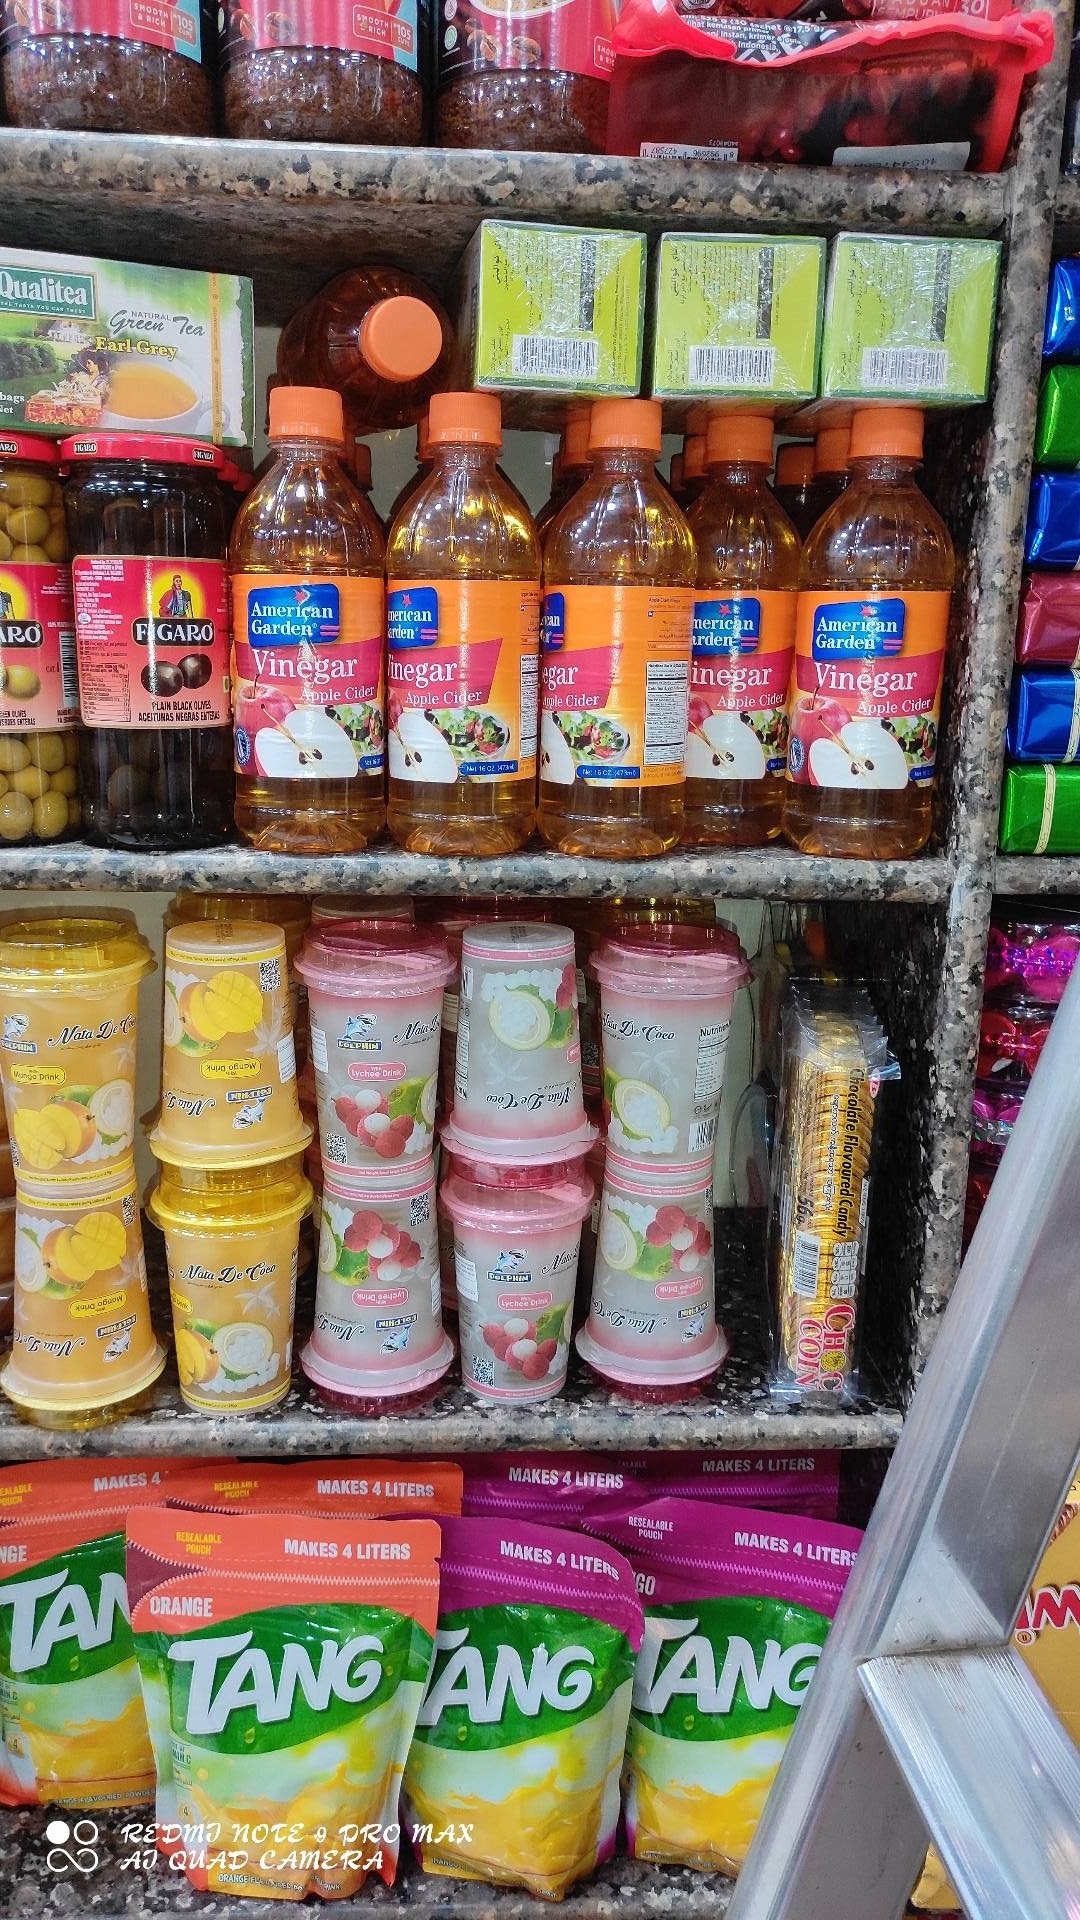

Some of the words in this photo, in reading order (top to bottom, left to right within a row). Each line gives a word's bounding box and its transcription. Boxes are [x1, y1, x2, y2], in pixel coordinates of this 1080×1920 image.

[134, 3, 168, 18] SMOOTH
[147, 15, 165, 27] RICH
[357, 14, 389, 28] SMOOTH
[369, 26, 385, 37] RICH
[0, 271, 88, 305] Qualitea
[110, 310, 164, 336] Green
[173, 316, 206, 337] Tea
[131, 310, 171, 322] NATURAL
[96, 336, 131, 353] Earl
[136, 341, 178, 360] Grey
[75, 443, 96, 453] FIGARO
[251, 602, 333, 623] American
[136, 623, 213, 642] FIGARO
[252, 623, 313, 636] Garden
[817, 616, 898, 633] American
[816, 634, 875, 650] Garden
[252, 649, 358, 685] Vinegar
[814, 662, 918, 698] Vinegar
[300, 687, 341, 704] Apple
[345, 686, 375, 700] Cider
[406, 691, 439, 707] Apple
[443, 690, 482, 704] Cider
[566, 694, 600, 707] Cider
[718, 696, 756, 709] Apple
[759, 693, 784, 706] Cider
[152, 702, 171, 712] PLAIN
[172, 701, 192, 712] BLACK
[193, 700, 212, 711] OLIVES
[857, 702, 897, 716] Apple
[901, 698, 931, 711] Cider
[138, 712, 173, 723] ACEITUNAS
[174, 711, 199, 722] NEGRAS
[48, 1026, 94, 1047] Nata
[97, 1020, 118, 1040] De
[393, 1021, 428, 1043] Nata
[620, 1020, 640, 1037] De
[642, 1025, 675, 1043] Coco
[339, 1041, 380, 1050] DOLPHIN
[40, 1072, 59, 1081] Drink
[206, 1064, 226, 1072] Drink
[352, 1068, 380, 1078] Lychee
[382, 1069, 402, 1077] Drink
[178, 1099, 216, 1116] Nata
[486, 1092, 519, 1110] Coco
[520, 1093, 545, 1112] De
[846, 1069, 865, 1132] Chocolate
[840, 1134, 859, 1197] Flavoured
[833, 1199, 853, 1238] Candy
[542, 1252, 572, 1275] Nata
[180, 1264, 215, 1281] Nata
[218, 1266, 243, 1284] De
[246, 1262, 277, 1281] Coco
[488, 1272, 530, 1283] DOLPHIN
[356, 1292, 376, 1301] Drink
[378, 1290, 405, 1300] Lychee
[659, 1285, 679, 1293] Drink
[76, 1304, 95, 1312] Drink
[502, 1300, 529, 1308] Lychee
[531, 1298, 549, 1307] Drink
[607, 1311, 626, 1328] De
[627, 1318, 667, 1335] Nata
[330, 1324, 365, 1341] Nata
[43, 1336, 86, 1358] Nata
[796, 1320, 824, 1390] COIN
[702, 1459, 752, 1474] MAKES
[755, 1458, 765, 1472] 4
[768, 1458, 815, 1472] LITERS
[94, 1472, 147, 1492] MAKES
[152, 1472, 162, 1485] 4
[214, 1480, 260, 1493] RESEALABLE
[509, 1467, 559, 1486] MAKES
[562, 1470, 572, 1486] 4
[575, 1471, 624, 1490] LITERS
[225, 1488, 250, 1498] POUCH
[317, 1479, 369, 1496] MAKES
[372, 1480, 382, 1496] 4
[385, 1481, 435, 1498] LITERS
[628, 1516, 674, 1532] RESEALABLE
[176, 1532, 223, 1545] RESEALABLE
[638, 1529, 663, 1541] POUCH
[186, 1543, 212, 1556] POUCH
[284, 1538, 339, 1558] MAKES
[342, 1542, 353, 1559] 4
[357, 1543, 411, 1560] LITERS
[734, 1532, 790, 1554] MAKES
[792, 1542, 803, 1557] 4
[807, 1544, 858, 1567] LITERS
[500, 1540, 554, 1565] MAKES
[557, 1551, 567, 1567] 4
[570, 1553, 620, 1582] LITERS
[150, 1595, 214, 1618] ORANGE
[167, 1630, 384, 1736] TANG
[218, 1874, 249, 1884] ORANGE
